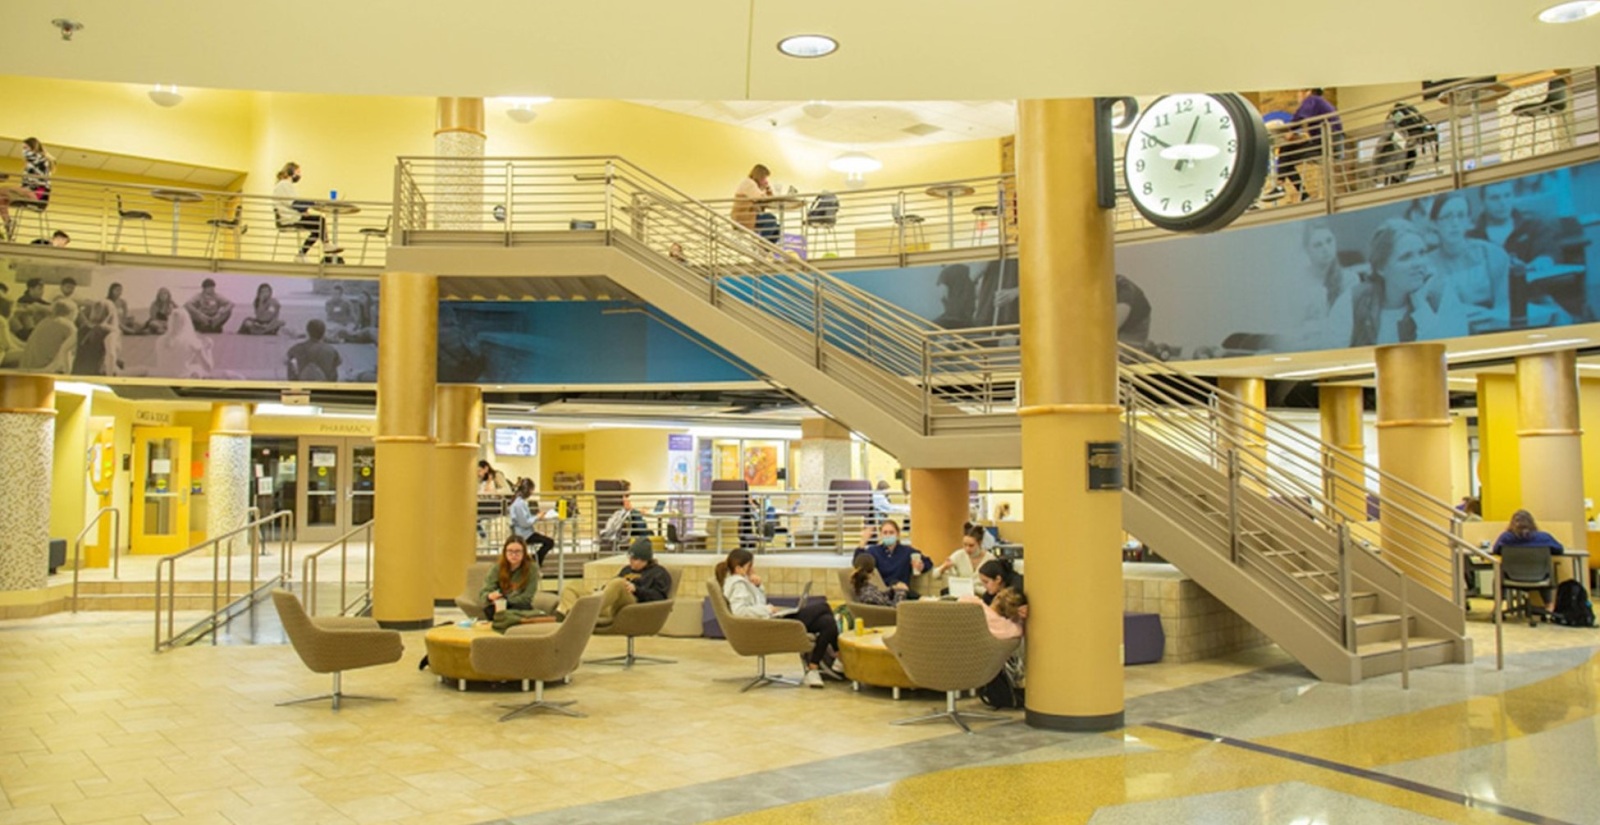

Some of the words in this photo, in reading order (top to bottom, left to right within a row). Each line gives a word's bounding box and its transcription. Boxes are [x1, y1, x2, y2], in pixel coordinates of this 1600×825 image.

[1176, 99, 1193, 114] 12
[1205, 102, 1212, 114] 1
[1155, 113, 1170, 127] 11
[1220, 116, 1230, 129] 2
[1141, 136, 1158, 150] 10
[1227, 139, 1237, 153] 3
[1136, 159, 1145, 172] 9
[1220, 166, 1229, 179] 4
[1143, 182, 1153, 195] 8
[1205, 189, 1214, 202] 5
[1161, 198, 1170, 211] 7
[1182, 200, 1192, 213] 6
[319, 423, 372, 434] PHARMACY
